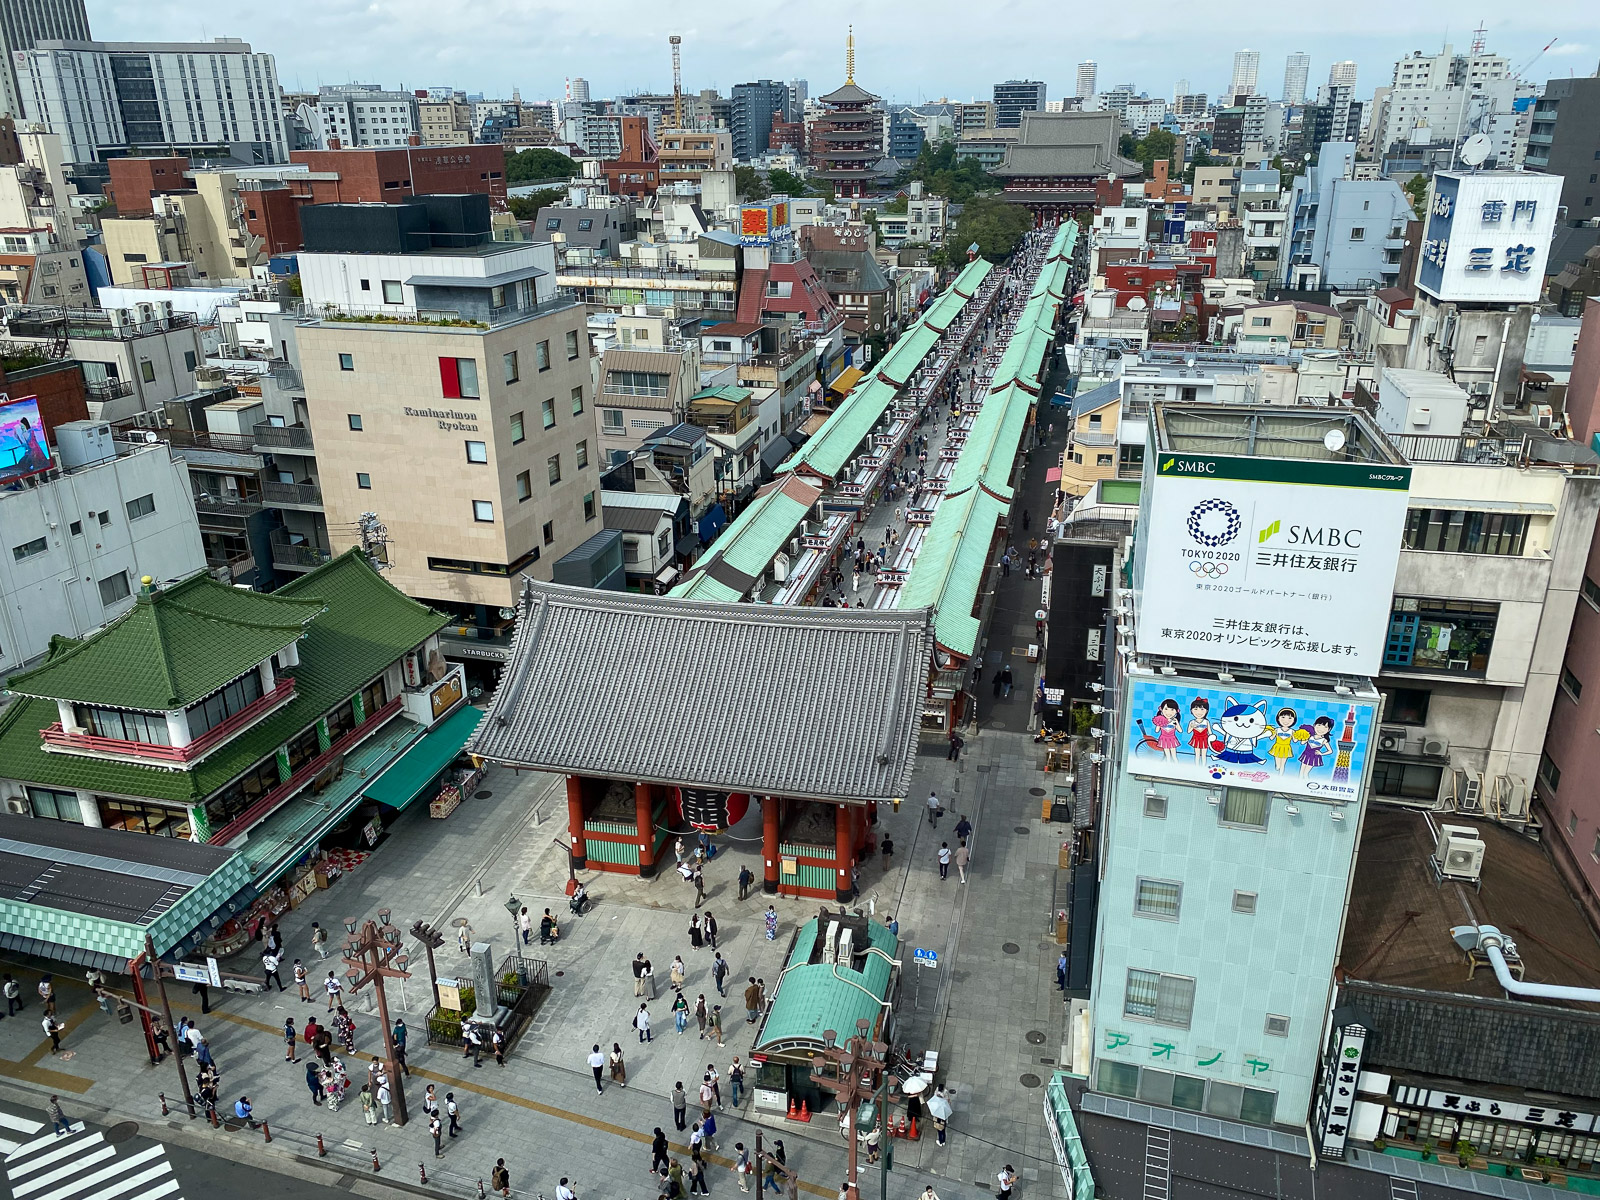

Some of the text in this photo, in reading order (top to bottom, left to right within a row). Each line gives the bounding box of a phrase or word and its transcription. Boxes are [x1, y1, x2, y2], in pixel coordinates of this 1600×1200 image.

[1481, 199, 1538, 222] 雷門
[741, 209, 768, 235] 薬
[1464, 243, 1536, 275] 三定
[404, 406, 478, 421] Kaminarimon
[437, 420, 479, 432] Ryokan
[1177, 460, 1216, 474] SMBC
[1368, 473, 1404, 482] SMBCグループ
[1287, 525, 1363, 549] SMBC
[1181, 548, 1241, 562] TOKYO 2020
[1255, 552, 1358, 573] 三井住友銀行
[1093, 567, 1104, 594] 天ぷら
[1212, 617, 1310, 637] 三井住友銀行は、
[462, 648, 505, 659] STARBUCKS
[1087, 639, 1099, 659] 三定
[1161, 627, 1359, 658] 東京2020オリンピックを応援します。
[1106, 1032, 1270, 1076] アオノヤ
[1327, 1062, 1357, 1137] 天ぷら 三定
[1443, 1095, 1578, 1128] 天ぷら 三定
